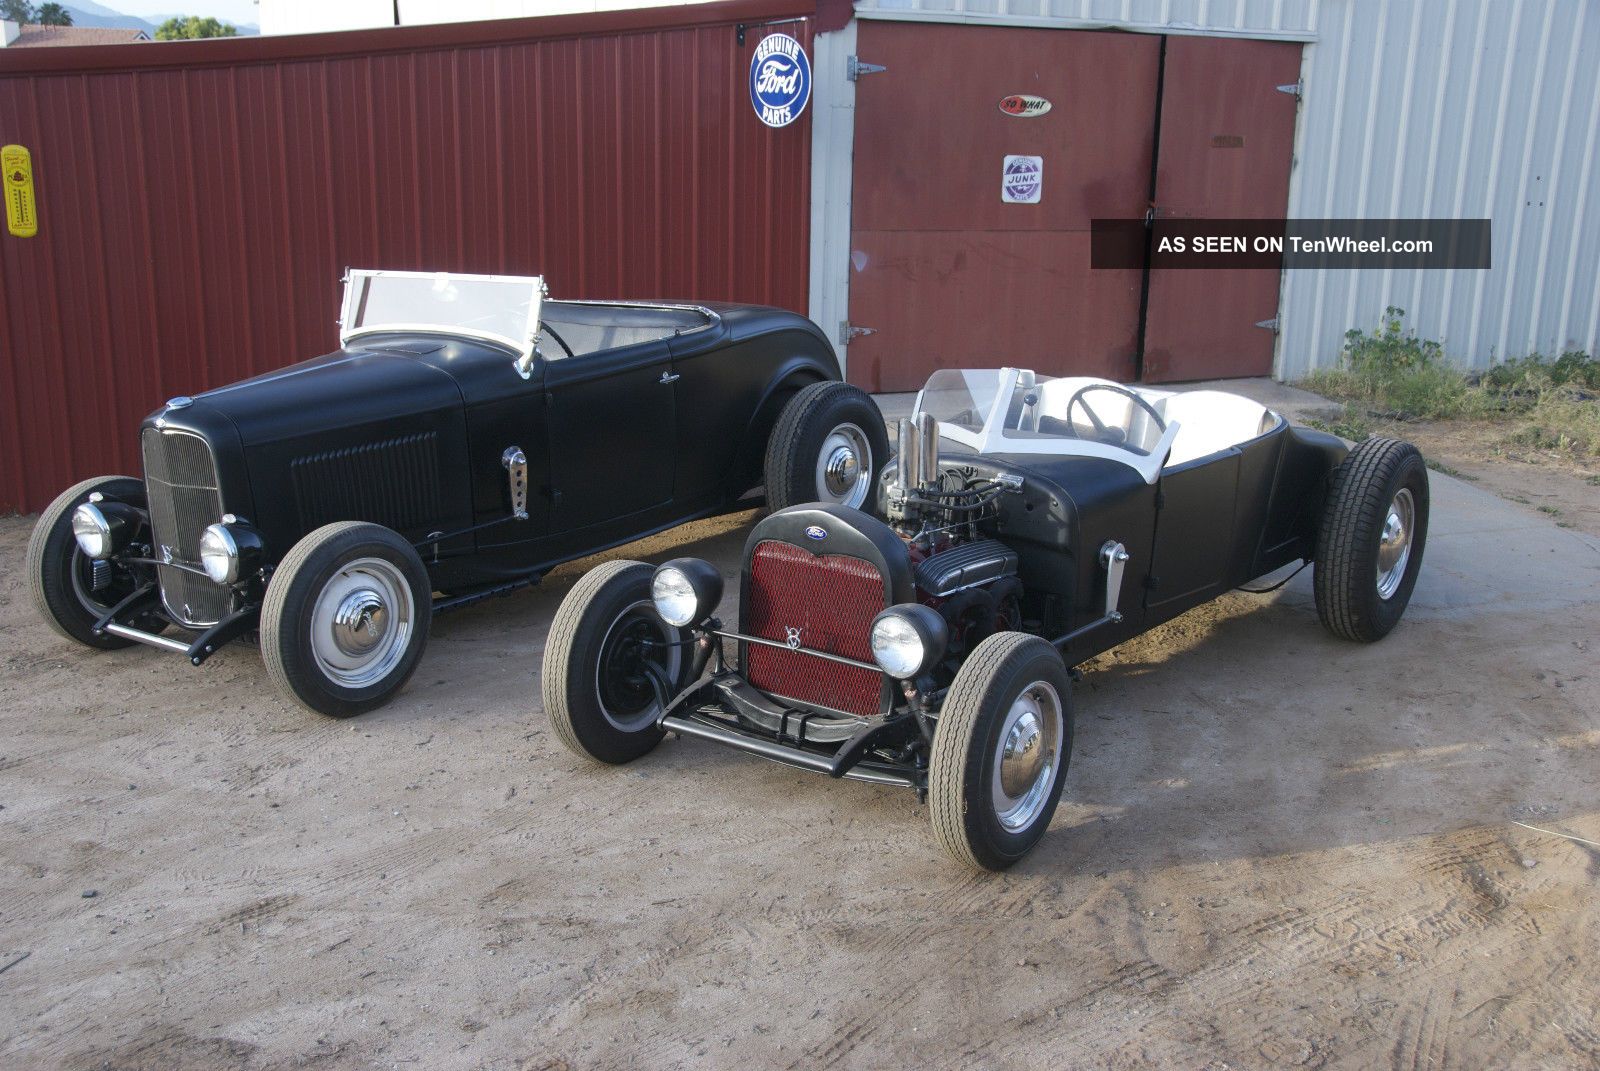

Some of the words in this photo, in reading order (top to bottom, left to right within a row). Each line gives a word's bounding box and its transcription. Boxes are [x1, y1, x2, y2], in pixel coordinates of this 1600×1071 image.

[757, 36, 800, 61] GENUINE
[757, 60, 800, 95] Ford
[762, 105, 792, 125] PARTS
[1020, 100, 1047, 110] WHAT
[1008, 174, 1036, 184] JUNK
